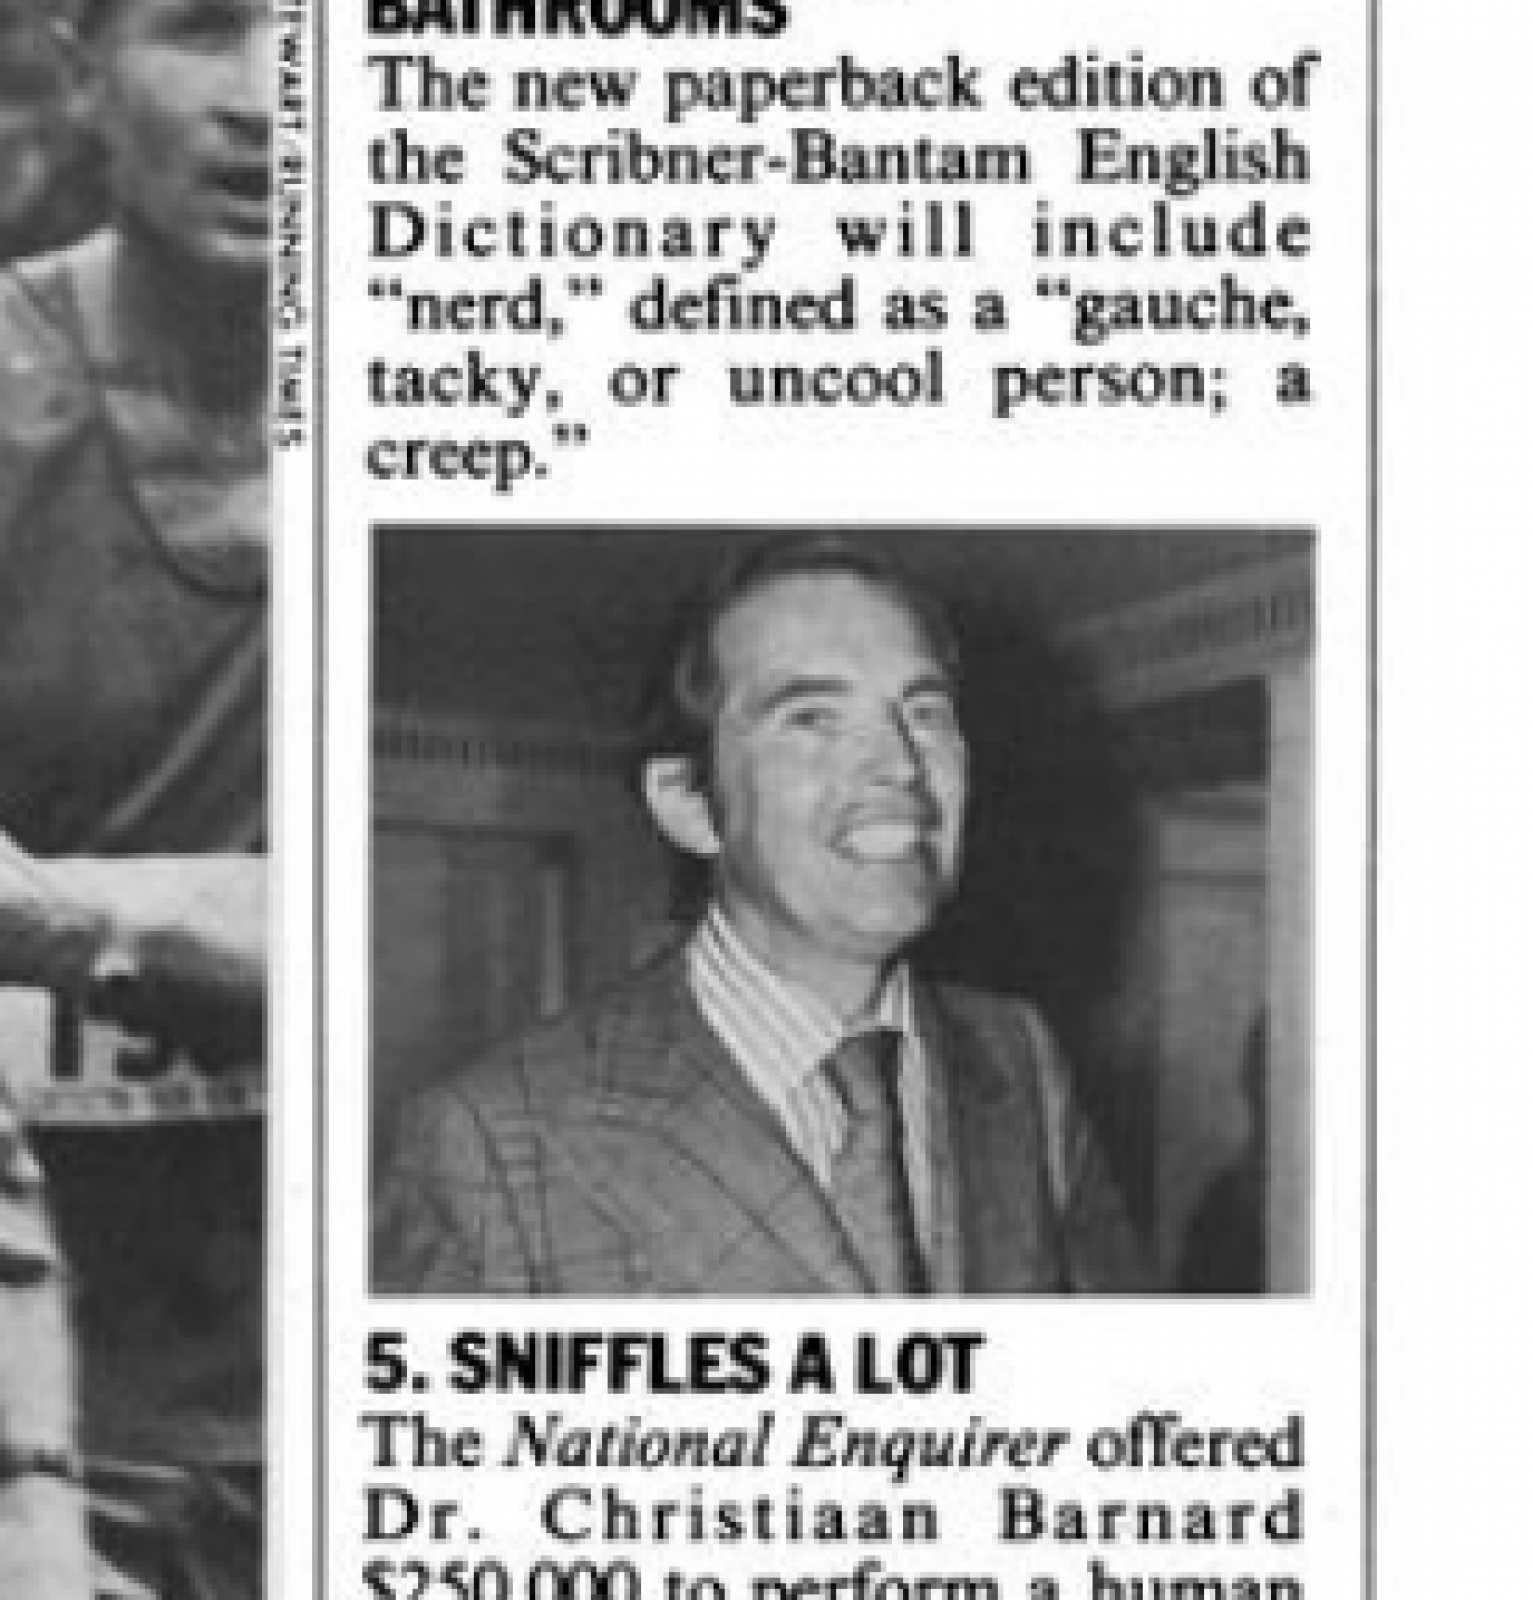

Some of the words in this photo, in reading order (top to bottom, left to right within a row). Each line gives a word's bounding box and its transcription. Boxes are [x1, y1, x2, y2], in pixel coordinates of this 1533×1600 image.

[367, 0, 788, 40] BATHROOMS
[367, 55, 492, 112] The
[512, 71, 638, 112] new
[663, 54, 983, 124] paperback
[1008, 54, 1223, 112] edition
[1248, 51, 1323, 112] of
[367, 127, 465, 185] the
[506, 127, 1033, 185] Scribner-Bantam
[1080, 127, 1312, 197] English
[372, 201, 777, 274] Dictionary
[835, 201, 972, 257] will
[1036, 201, 1312, 258] include
[629, 273, 855, 330] defined
[885, 289, 950, 330] as
[974, 294, 1011, 330] a
[278, 345, 306, 451] TIMES
[367, 350, 560, 419] tacky,
[607, 367, 682, 408] or
[729, 350, 944, 408] uncool
[992, 361, 1228, 419] person;
[1276, 362, 1312, 403] a
[367, 1331, 431, 1395] 5.
[450, 1331, 772, 1395] SNIFFLES
[790, 1331, 838, 1395] A
[857, 1331, 989, 1395] LOT
[361, 1412, 482, 1467] The
[501, 1412, 777, 1467] National
[791, 1415, 1072, 1484] Enquirer
[1086, 1412, 1306, 1472] offered
[362, 1487, 482, 1540] Dr.
[540, 1487, 939, 1545] Christiaan
[997, 1487, 1306, 1545] Barnard
[361, 1560, 643, 1600] $250000
